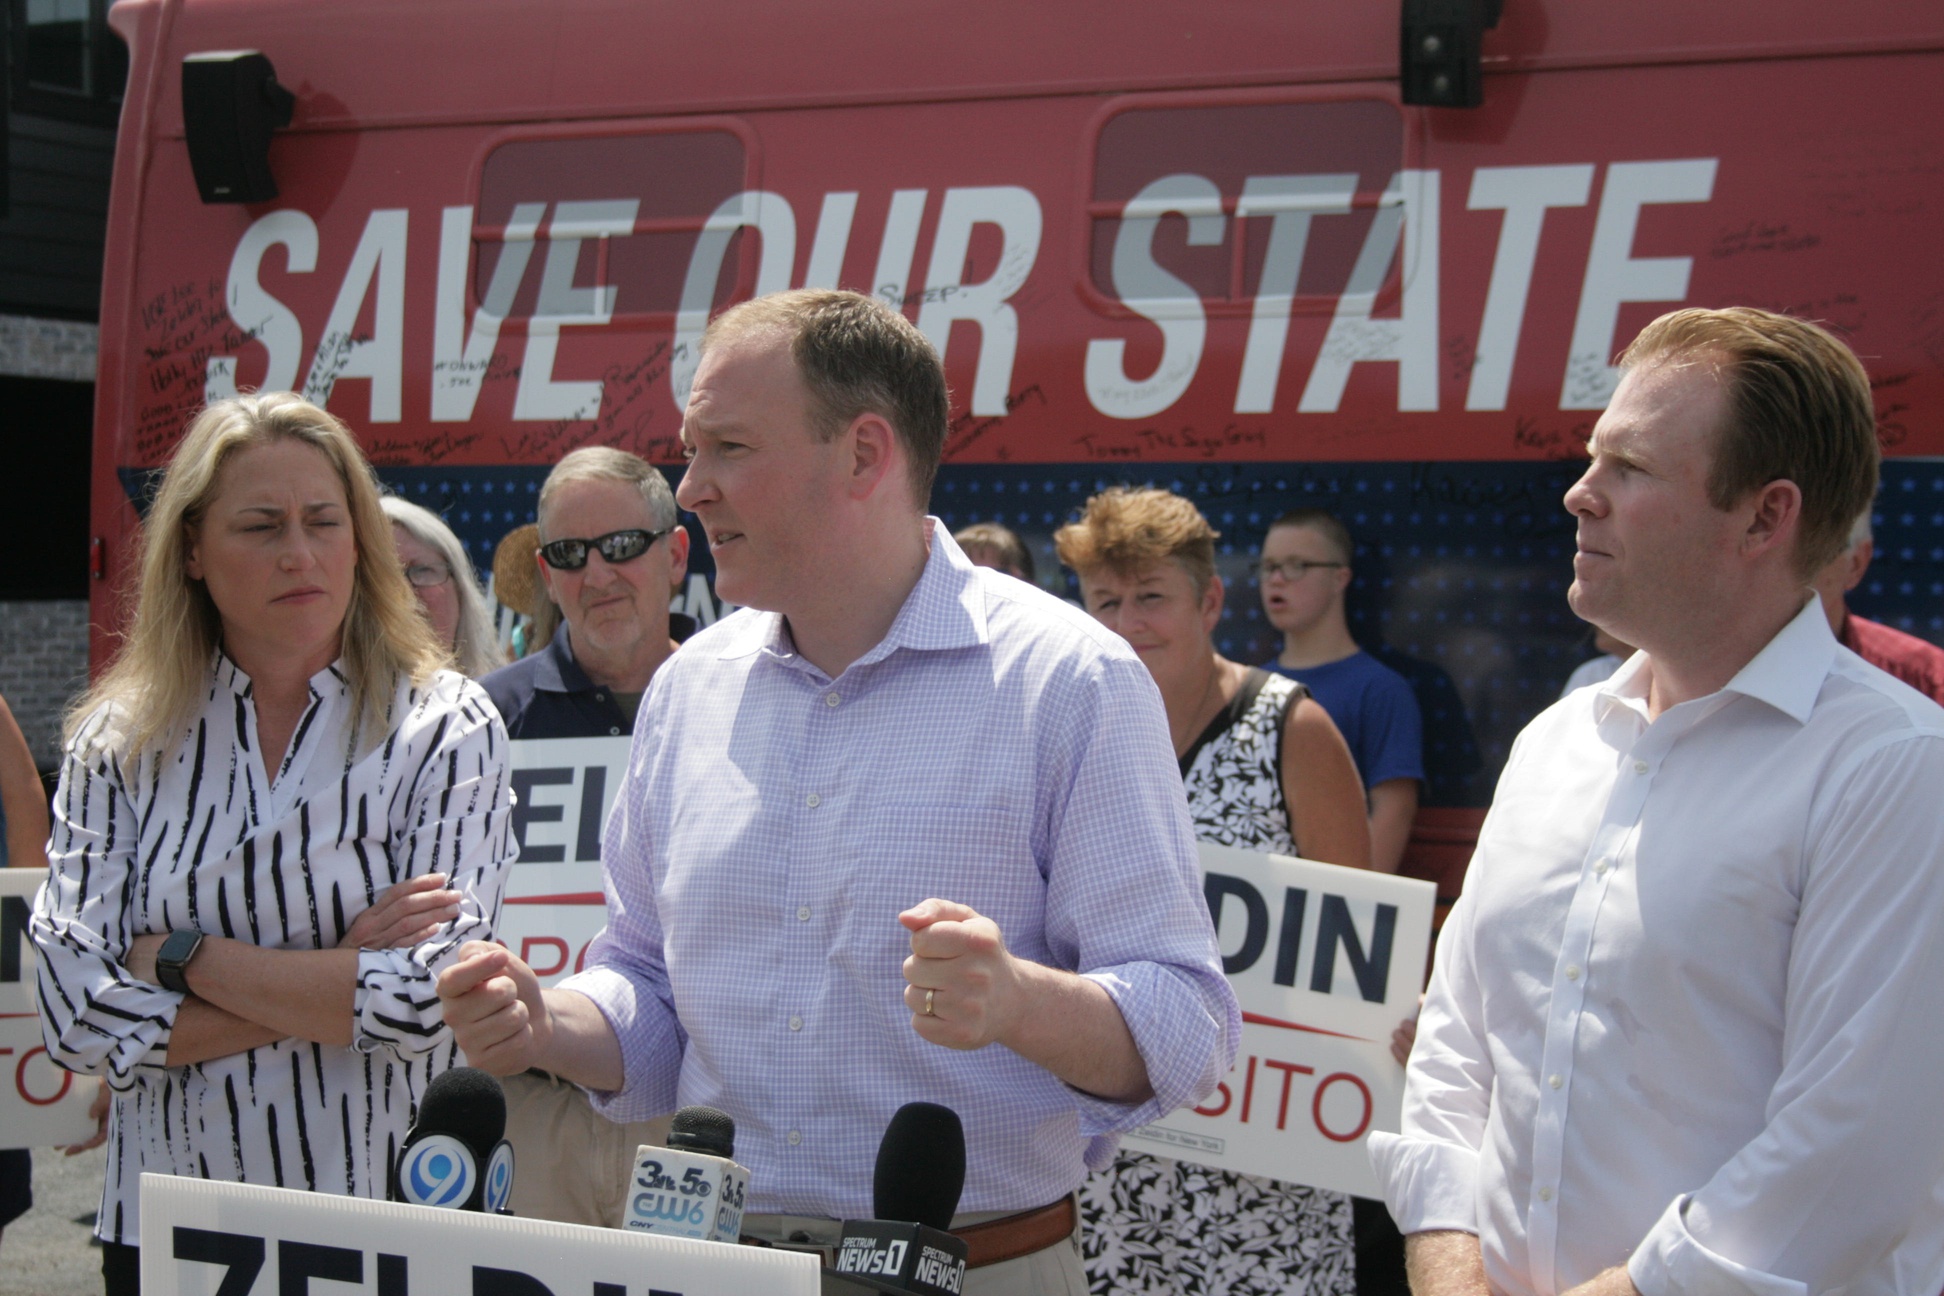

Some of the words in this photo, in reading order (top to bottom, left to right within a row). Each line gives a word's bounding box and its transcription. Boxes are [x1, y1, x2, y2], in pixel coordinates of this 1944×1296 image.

[205, 200, 640, 422] SAVE
[1084, 158, 1718, 417] STATE
[1203, 871, 1398, 1004] DIN
[842, 1237, 877, 1248] SPECTRUM
[921, 1245, 953, 1265] SPECTRUM
